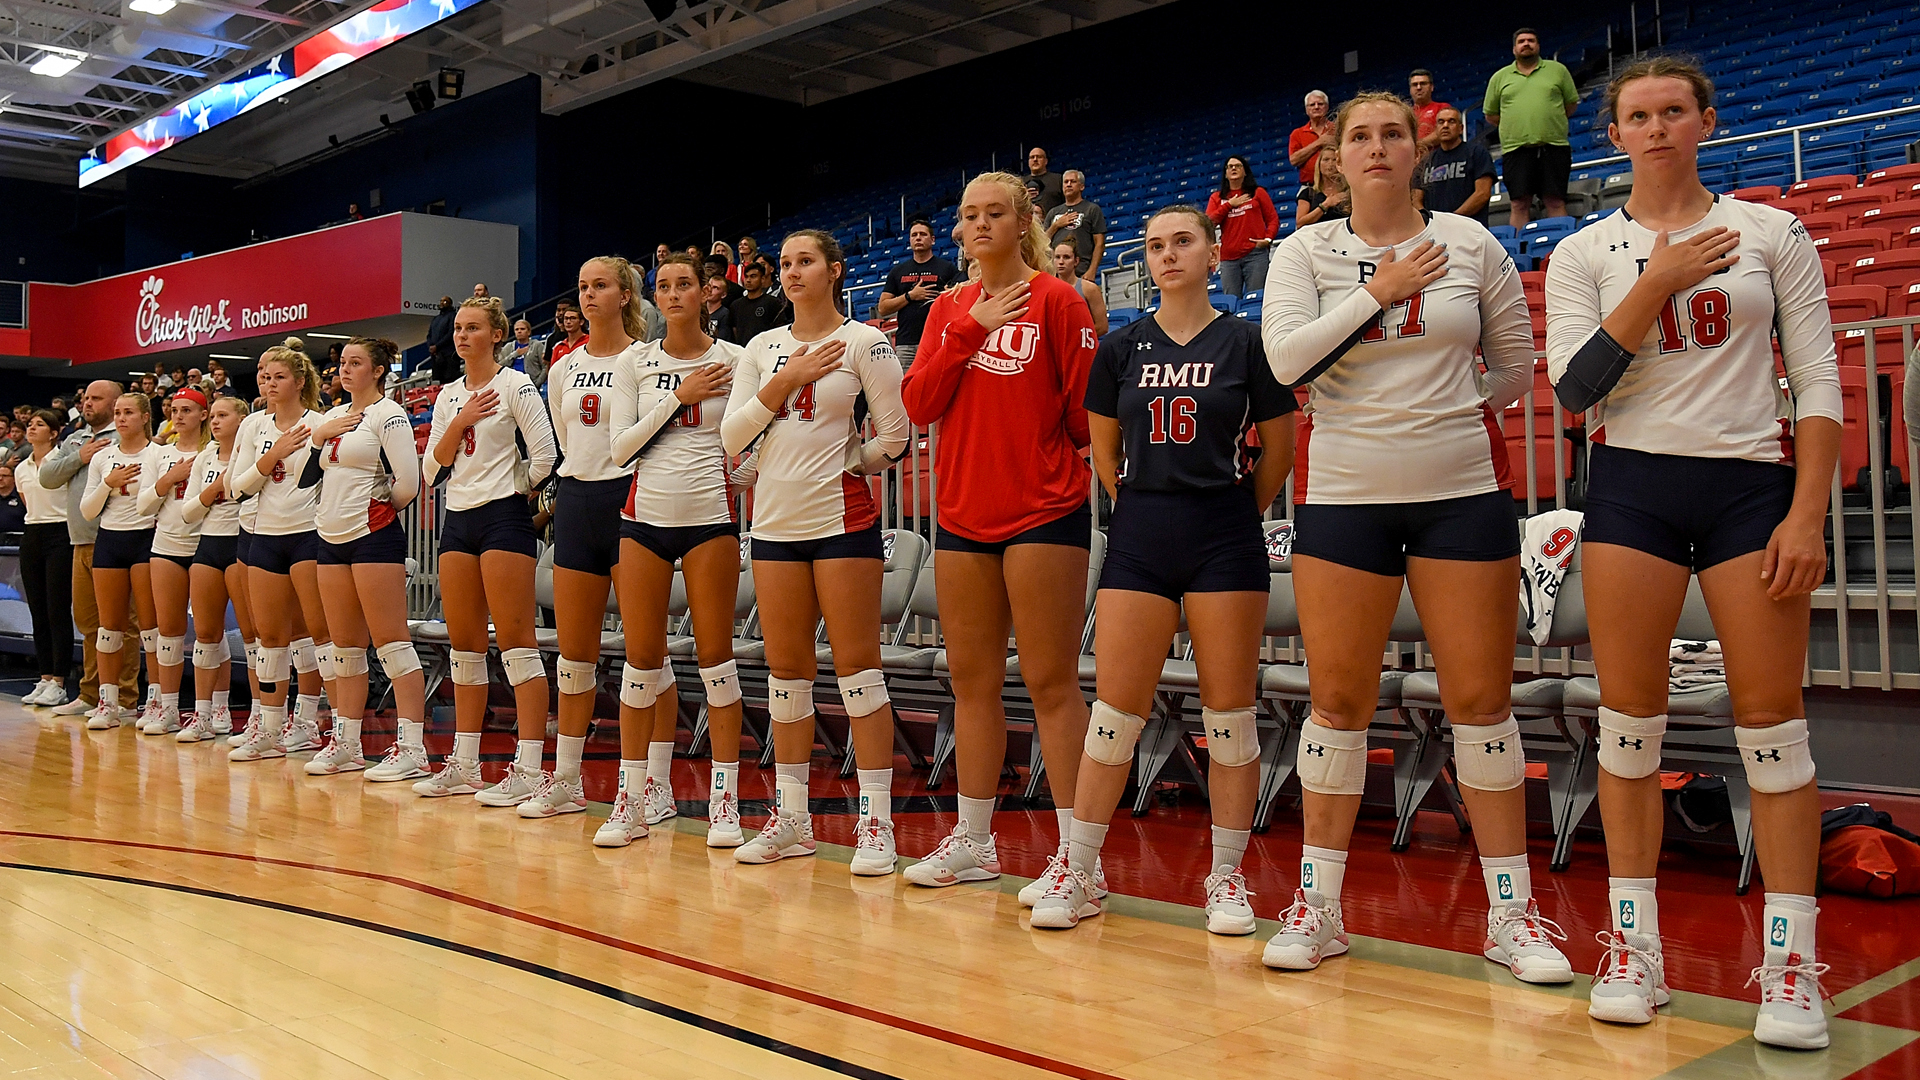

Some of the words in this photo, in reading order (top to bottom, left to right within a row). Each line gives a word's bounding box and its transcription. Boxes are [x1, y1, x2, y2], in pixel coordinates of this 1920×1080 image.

[1040, 103, 1060, 121] 105
[1069, 95, 1091, 113] 106
[242, 303, 308, 329] Robinson
[1657, 287, 1731, 354] 18
[1080, 327, 1095, 350] 15
[1138, 363, 1215, 388] RMU
[579, 392, 602, 427] 9
[1148, 396, 1197, 444] 16
[326, 436, 344, 464] 7
[463, 425, 476, 457] 8
